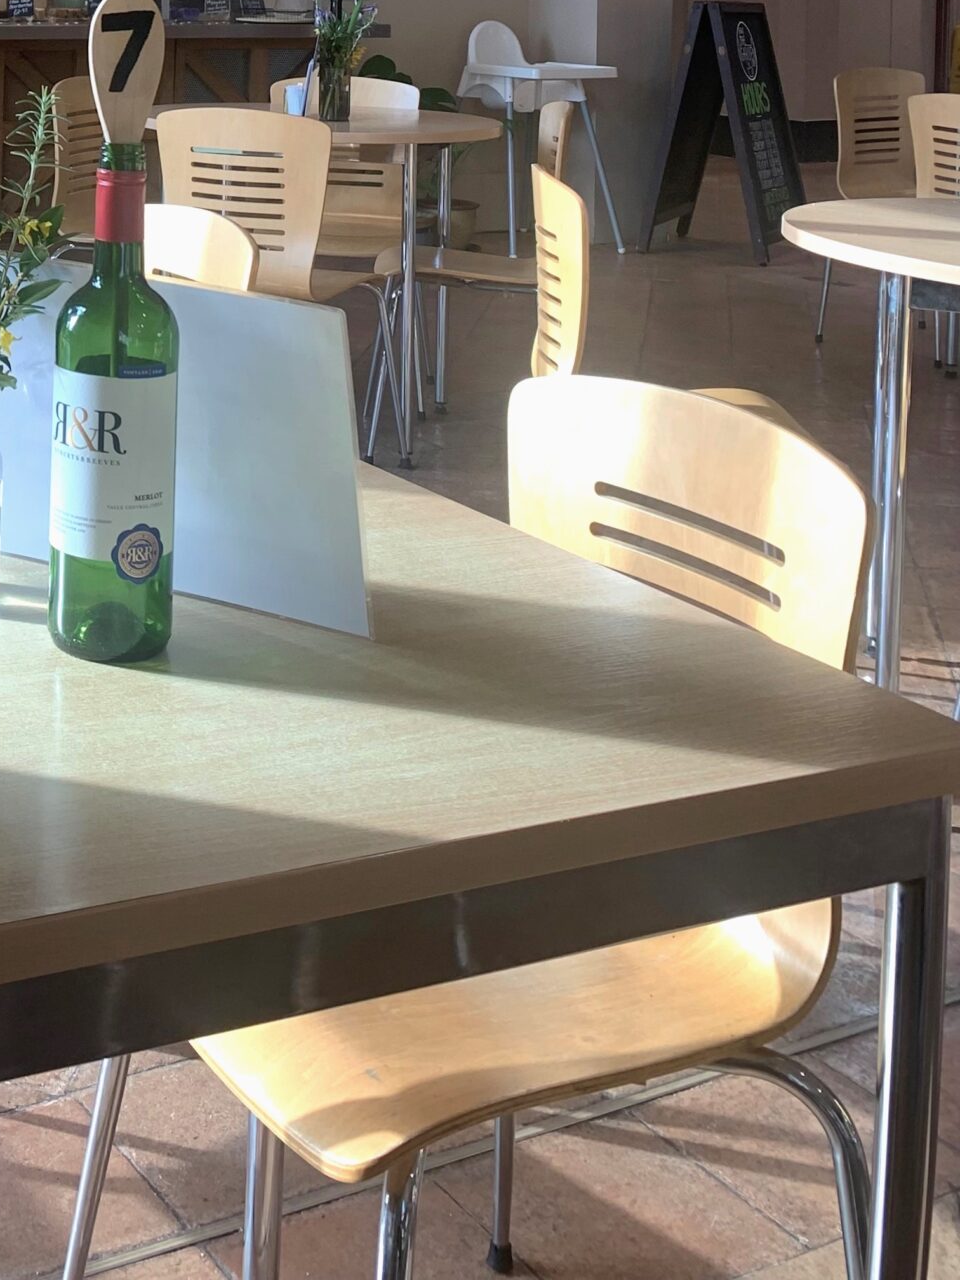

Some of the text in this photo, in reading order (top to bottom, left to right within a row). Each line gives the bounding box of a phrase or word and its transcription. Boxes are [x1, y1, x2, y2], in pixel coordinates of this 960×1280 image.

[101, 10, 156, 93] 7
[741, 81, 771, 116] HOURS
[134, 491, 163, 502] MERLOT
